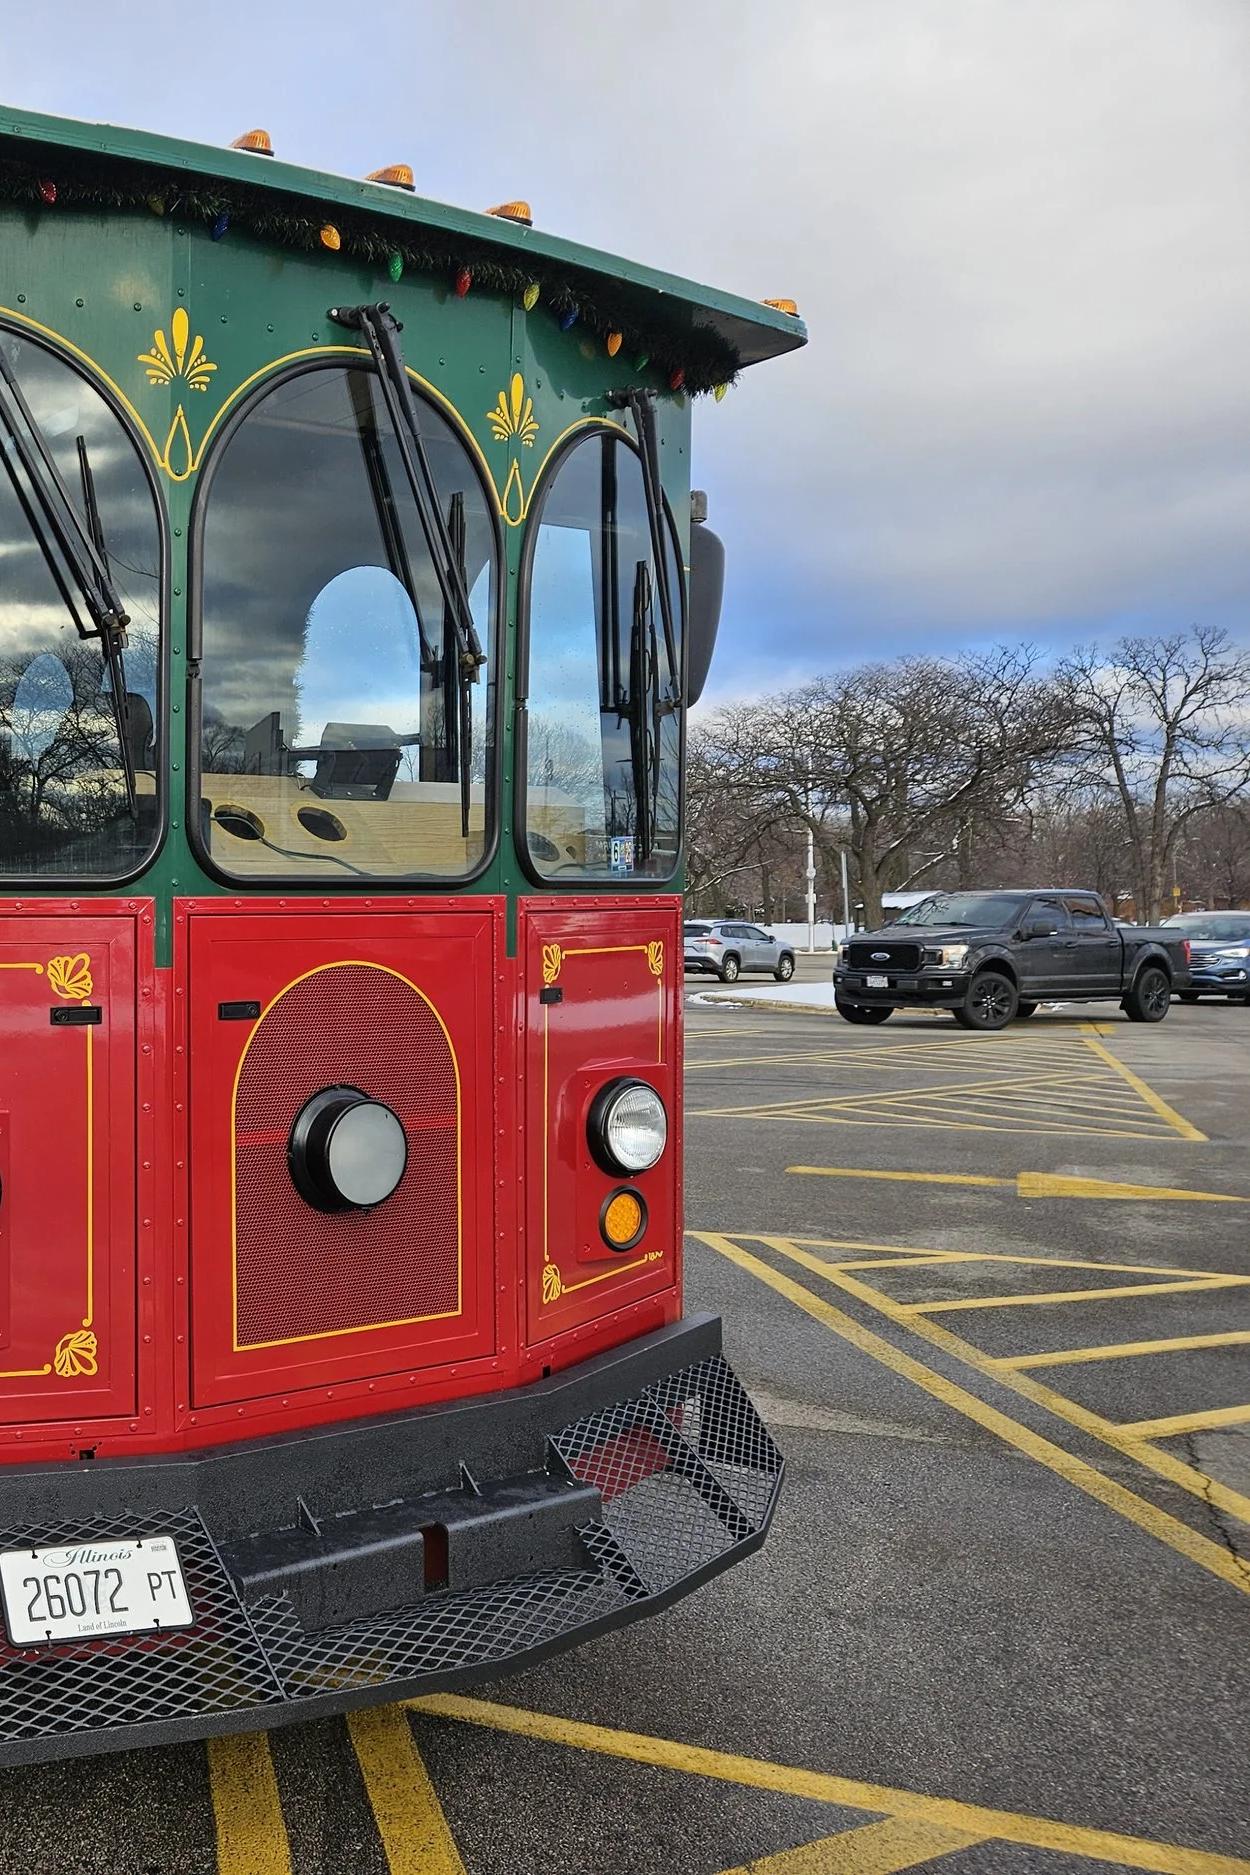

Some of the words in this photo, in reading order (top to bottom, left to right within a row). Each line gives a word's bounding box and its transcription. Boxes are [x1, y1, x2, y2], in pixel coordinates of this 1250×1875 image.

[42, 1546, 134, 1569] Illinois
[22, 1568, 129, 1623] 26072
[146, 1570, 177, 1602] PT
[77, 1622, 95, 1632] Land
[96, 1621, 102, 1630] of
[103, 1619, 128, 1629] Lincoln
